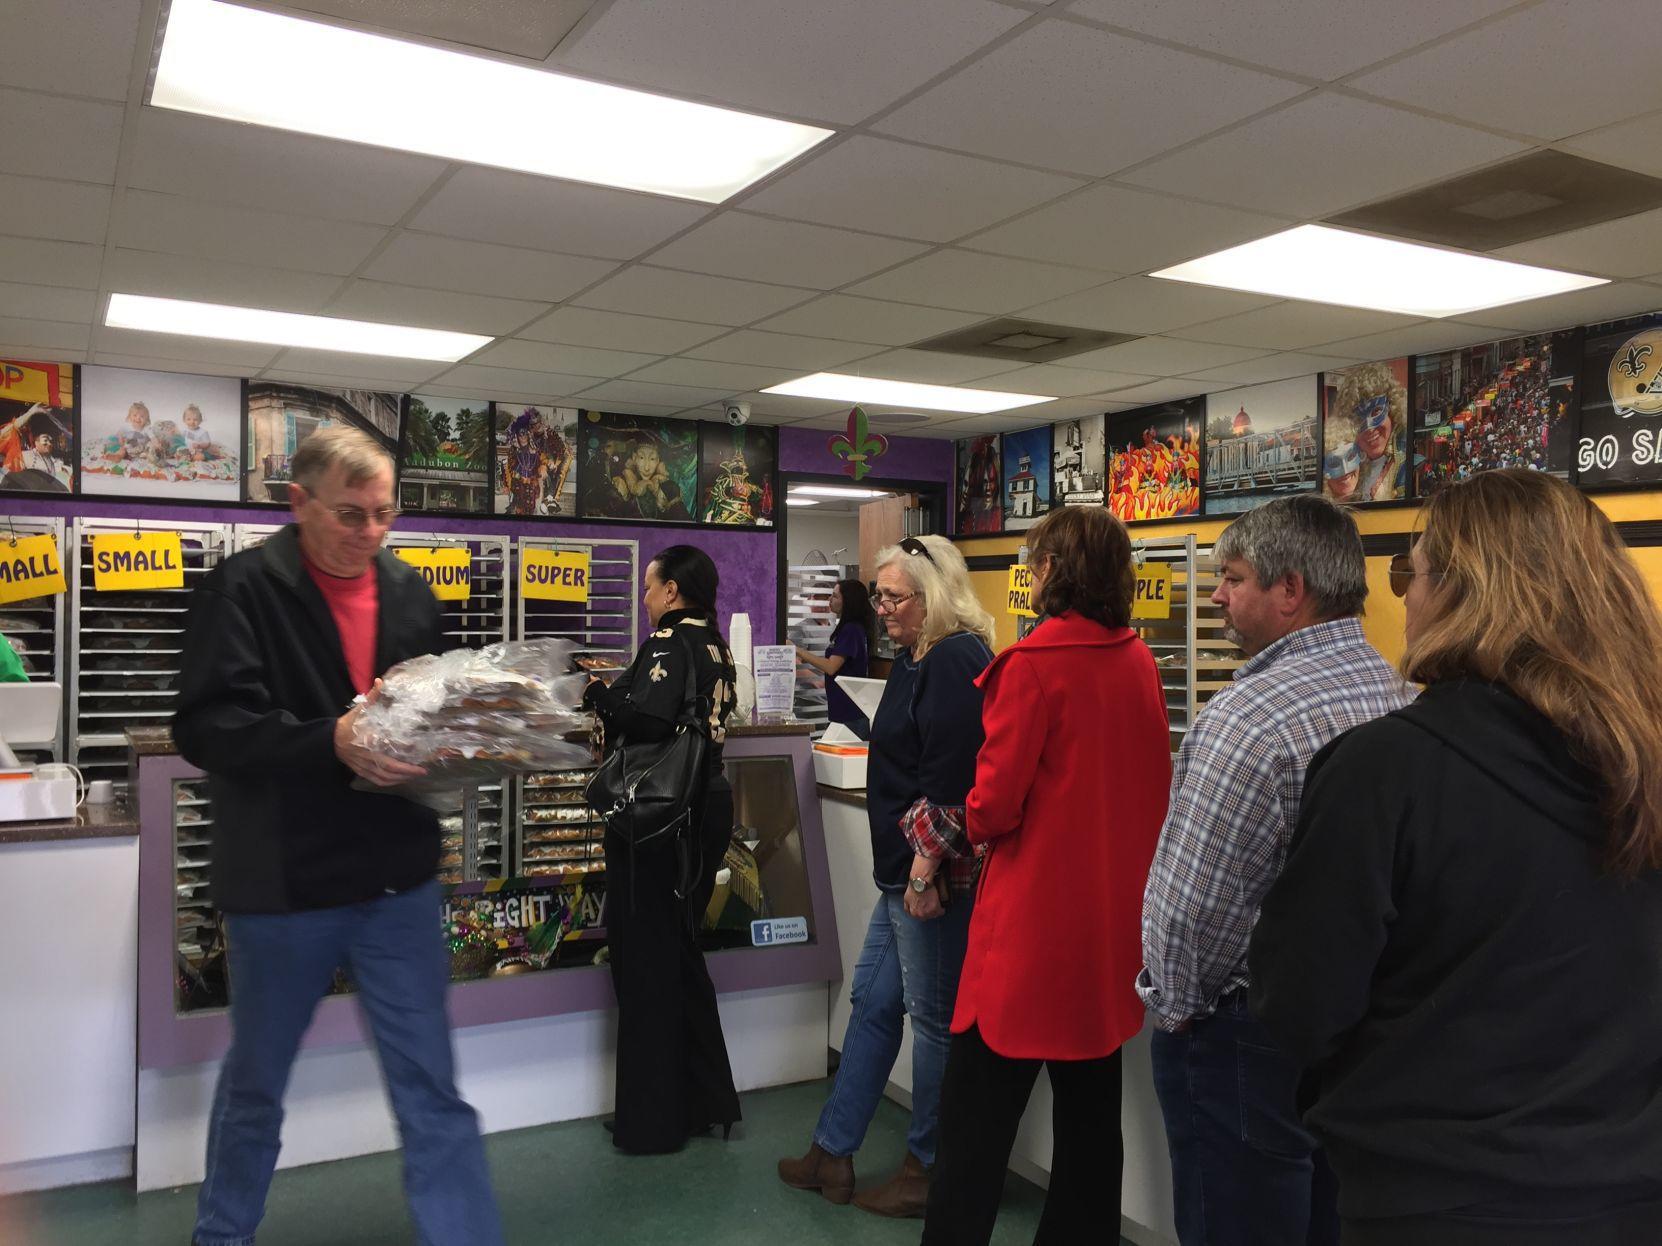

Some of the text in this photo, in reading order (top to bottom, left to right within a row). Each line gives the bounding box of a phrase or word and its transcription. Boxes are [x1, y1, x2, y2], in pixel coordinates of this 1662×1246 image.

[0, 365, 24, 389] P
[1578, 428, 1662, 472] GO S
[404, 457, 488, 471] Audubon Zoo
[98, 549, 177, 573] SMALL
[526, 564, 586, 587] SUPER
[1014, 569, 1032, 588] PEC
[775, 930, 806, 940] Facebook
